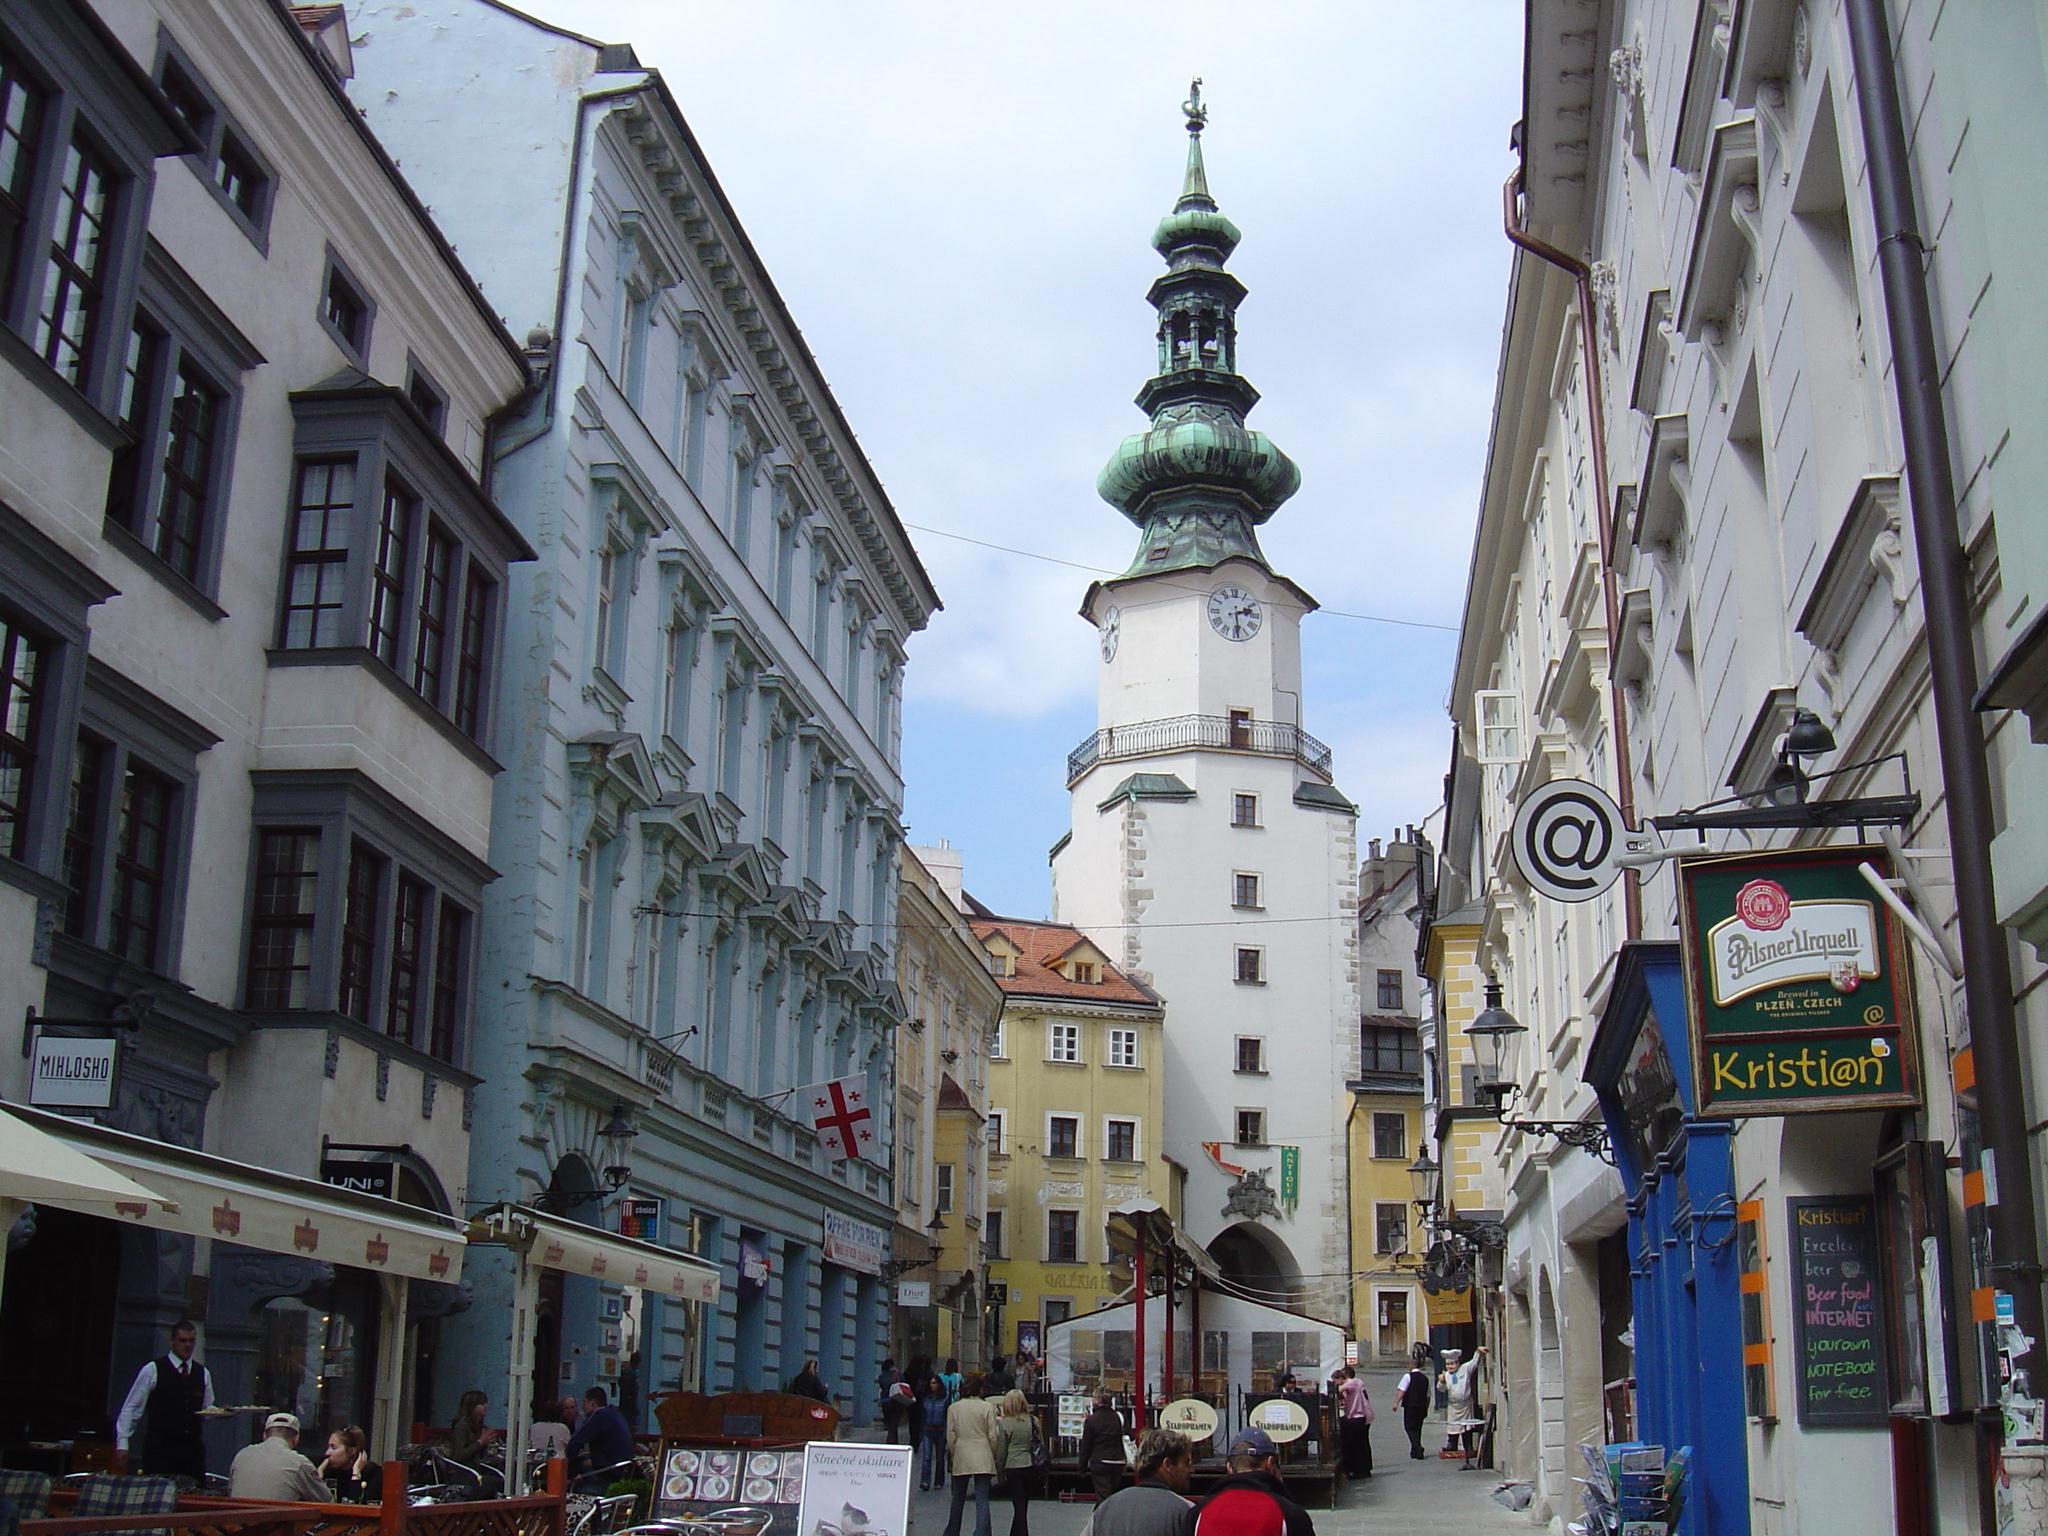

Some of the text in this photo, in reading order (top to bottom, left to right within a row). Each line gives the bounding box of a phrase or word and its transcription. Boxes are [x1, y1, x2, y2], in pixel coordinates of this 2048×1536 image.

[1727, 927, 1859, 981] Pilsner Urquell
[1777, 989, 1808, 999] Brewed
[1803, 998, 1842, 1008] CZECH
[1712, 1047, 1884, 1090] Kristi@n
[1286, 1152, 1294, 1194] ANTIQUE
[903, 1288, 924, 1297] Dior
[1807, 1280, 1871, 1307] Beer food
[858, 1455, 905, 1468] okuliare
